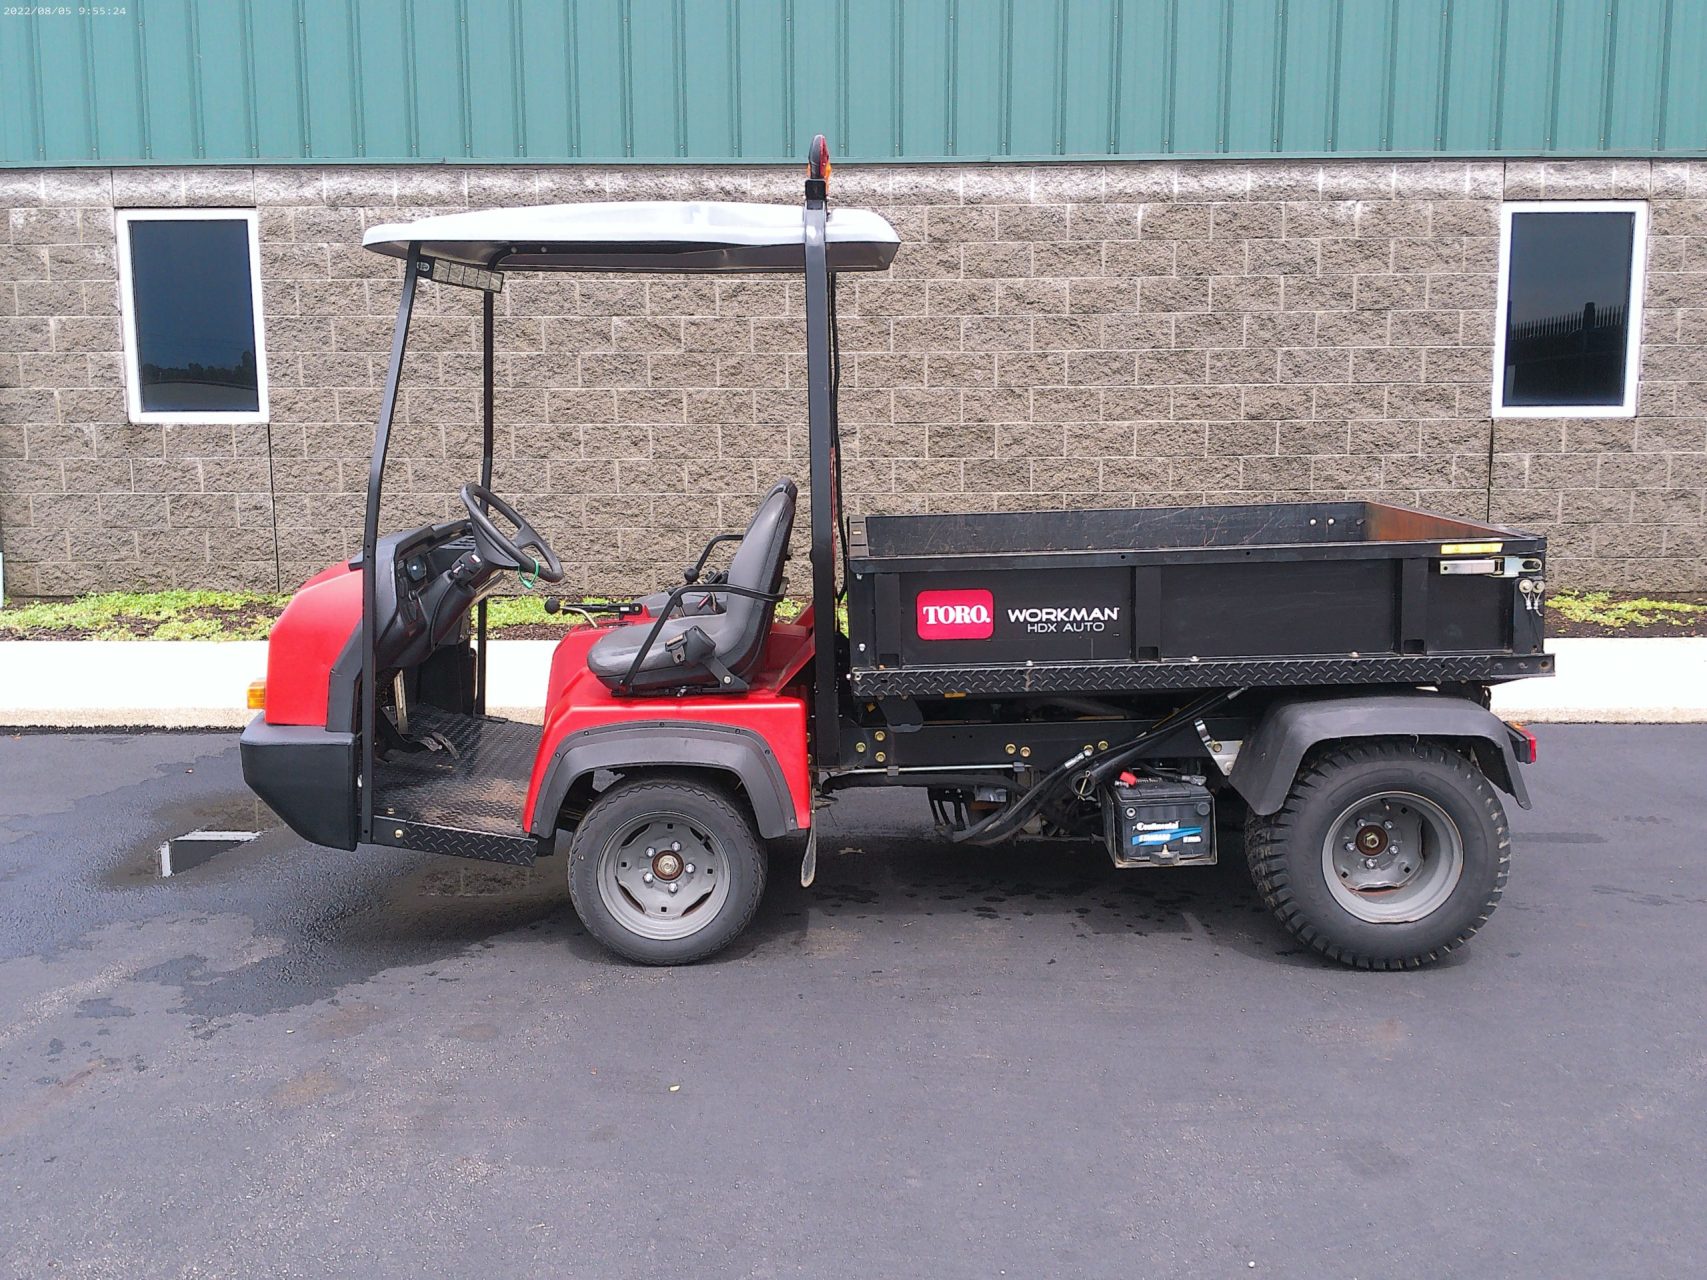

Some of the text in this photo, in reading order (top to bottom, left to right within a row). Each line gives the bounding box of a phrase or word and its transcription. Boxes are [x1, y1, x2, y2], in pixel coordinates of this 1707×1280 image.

[1007, 607, 1119, 622] WORKMAN
[1027, 622, 1105, 633] HDX AUTO
